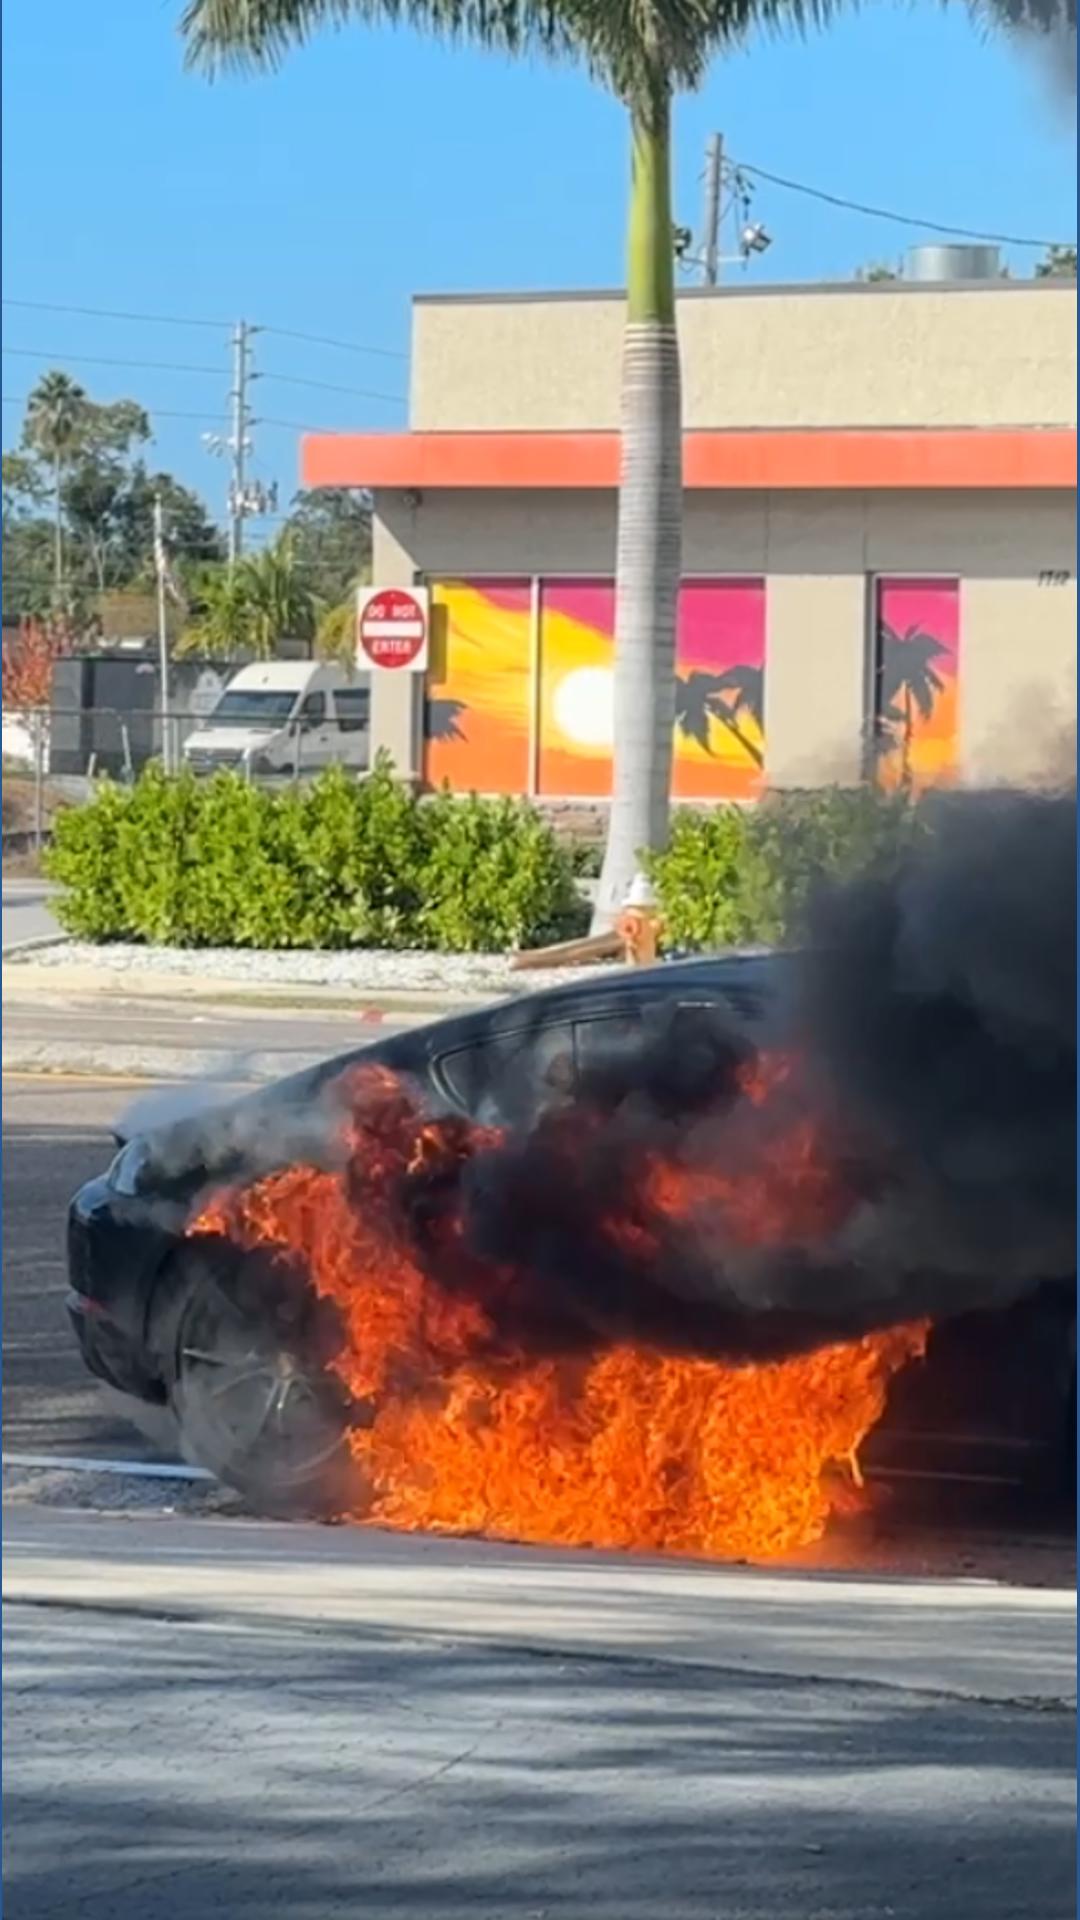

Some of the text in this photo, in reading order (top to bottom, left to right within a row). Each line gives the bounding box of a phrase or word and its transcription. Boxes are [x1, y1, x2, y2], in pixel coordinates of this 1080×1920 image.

[367, 603, 416, 619] DO NOT
[371, 639, 412, 655] ENTER
